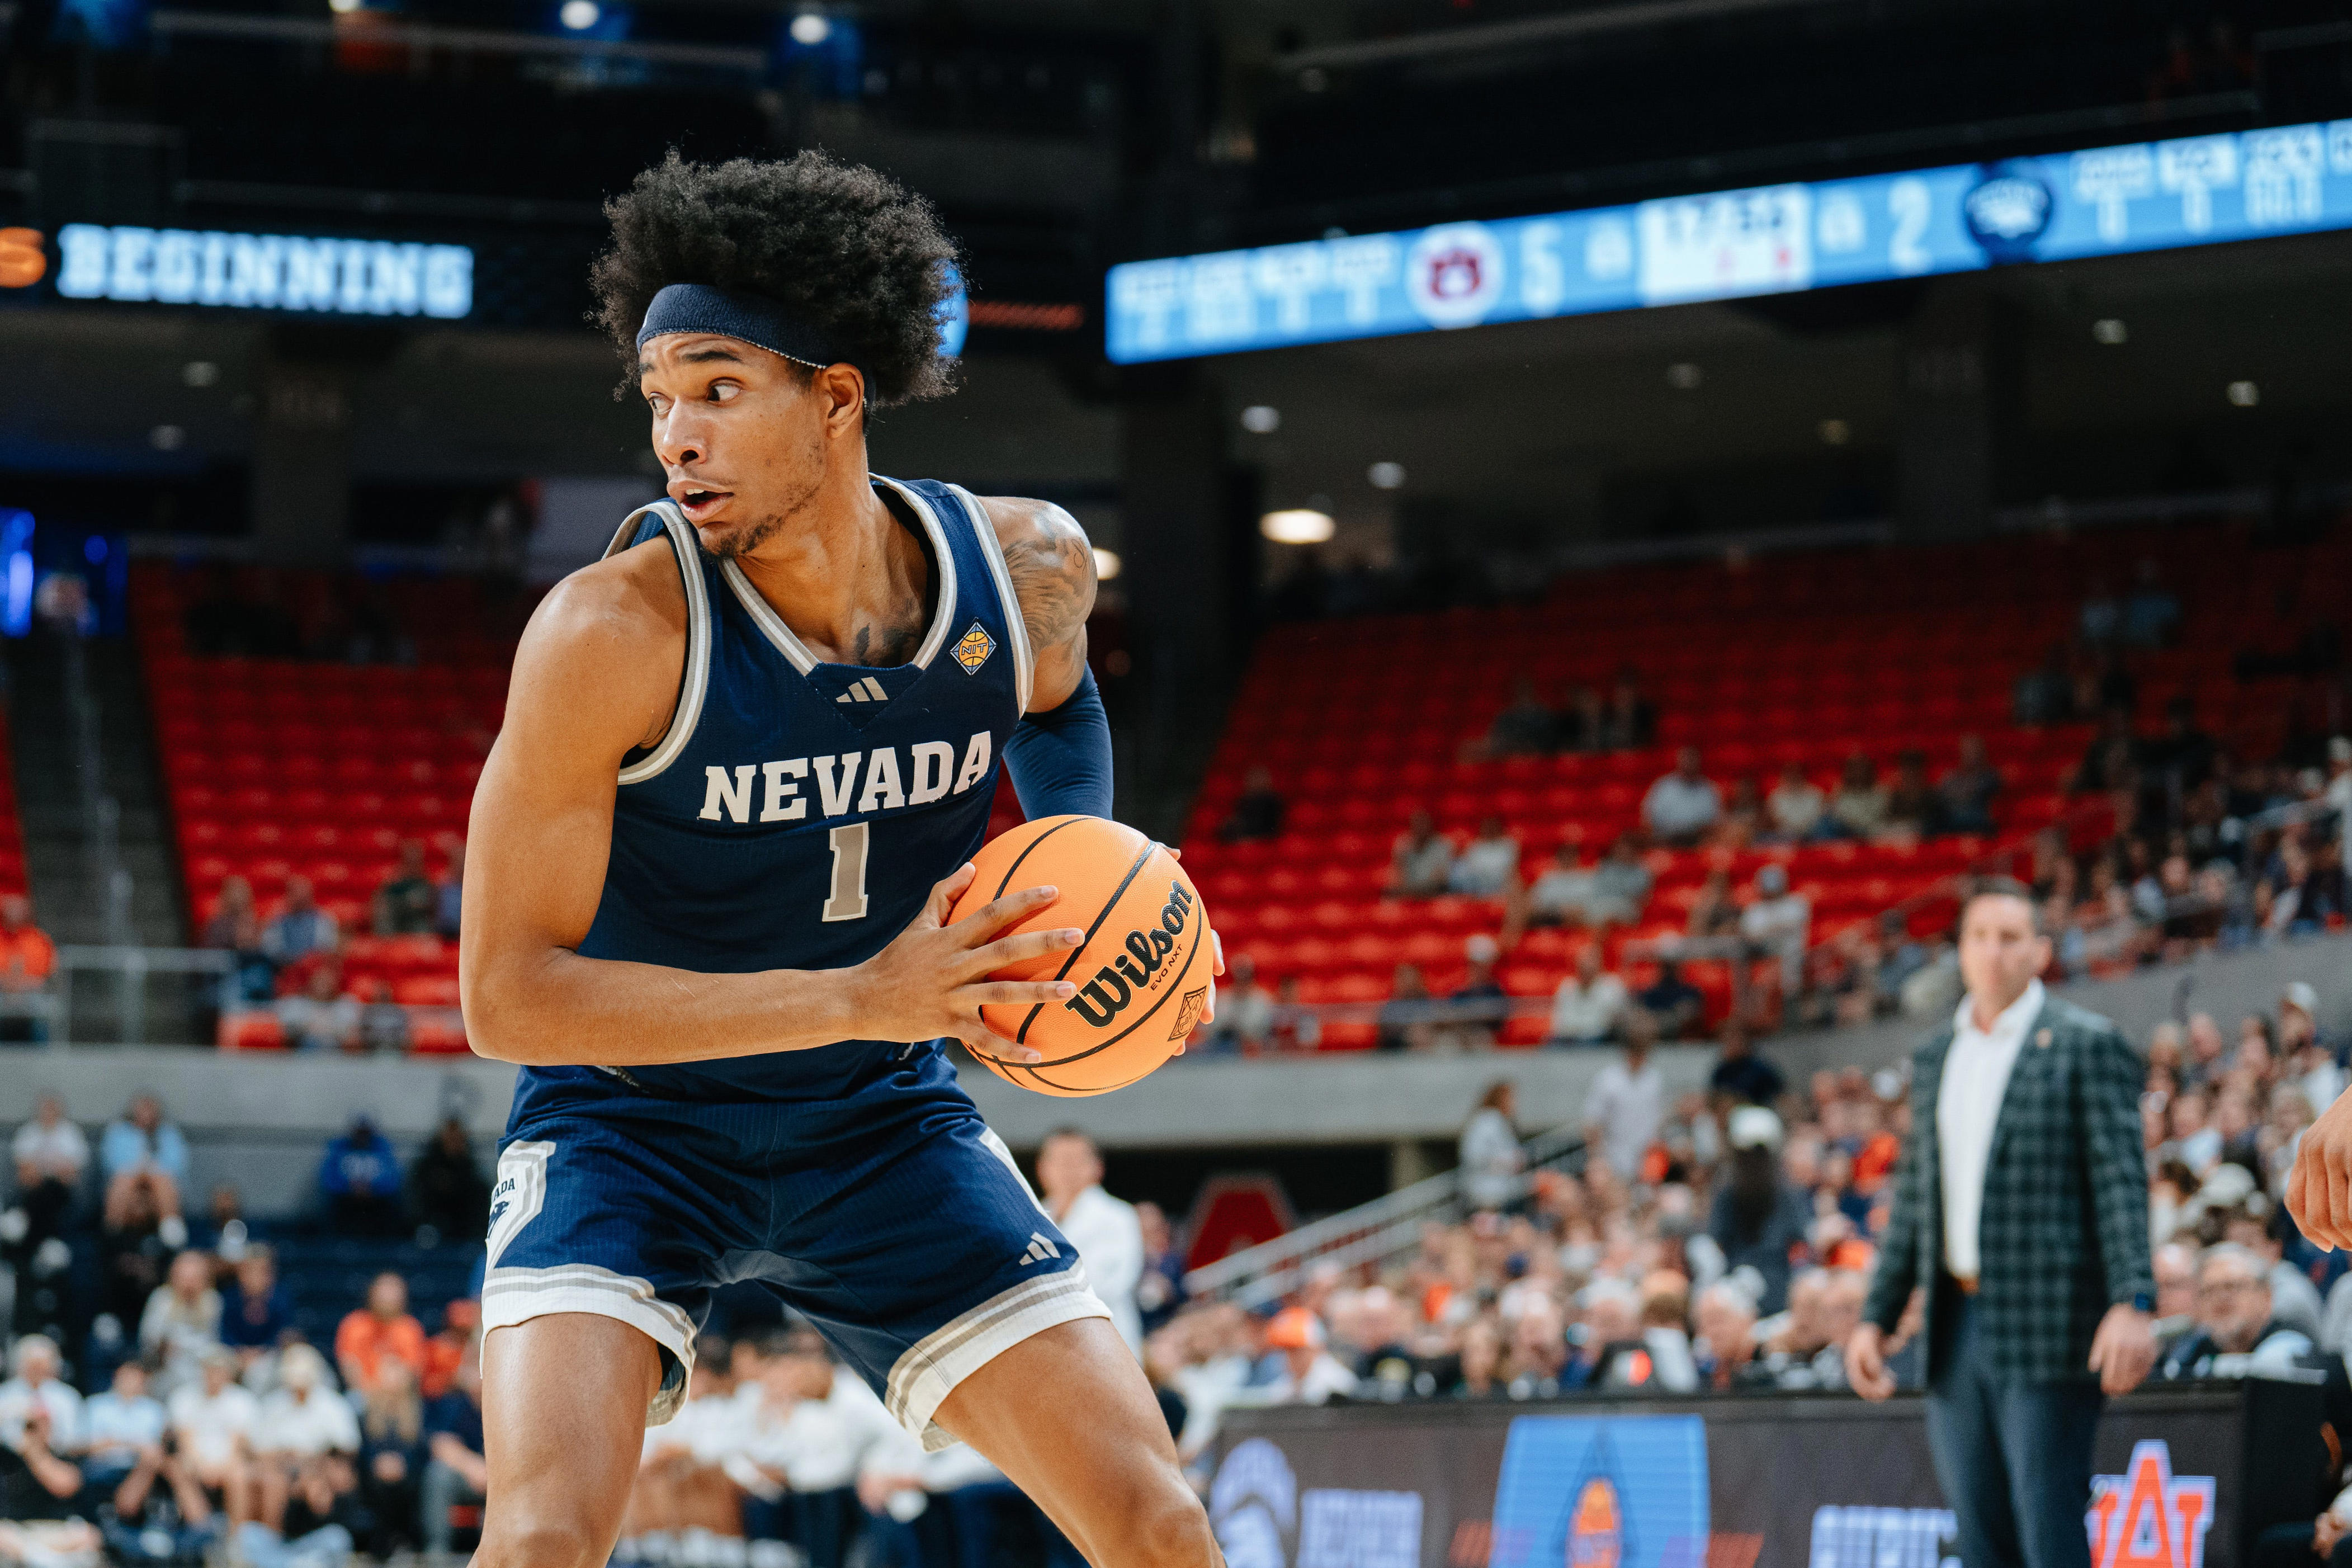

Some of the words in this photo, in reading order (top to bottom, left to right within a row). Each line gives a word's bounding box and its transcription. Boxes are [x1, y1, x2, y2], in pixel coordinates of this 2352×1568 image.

[56, 223, 475, 319] BEGINNING
[1887, 177, 1934, 275] 2
[961, 643, 988, 655] NIT
[697, 730, 991, 823] NEVADA
[821, 821, 869, 922] 1
[1064, 880, 1193, 1028] Wilson
[1150, 968, 1168, 991] EVO
[1168, 944, 1183, 967] NXT
[492, 1178, 516, 1202] ADA
